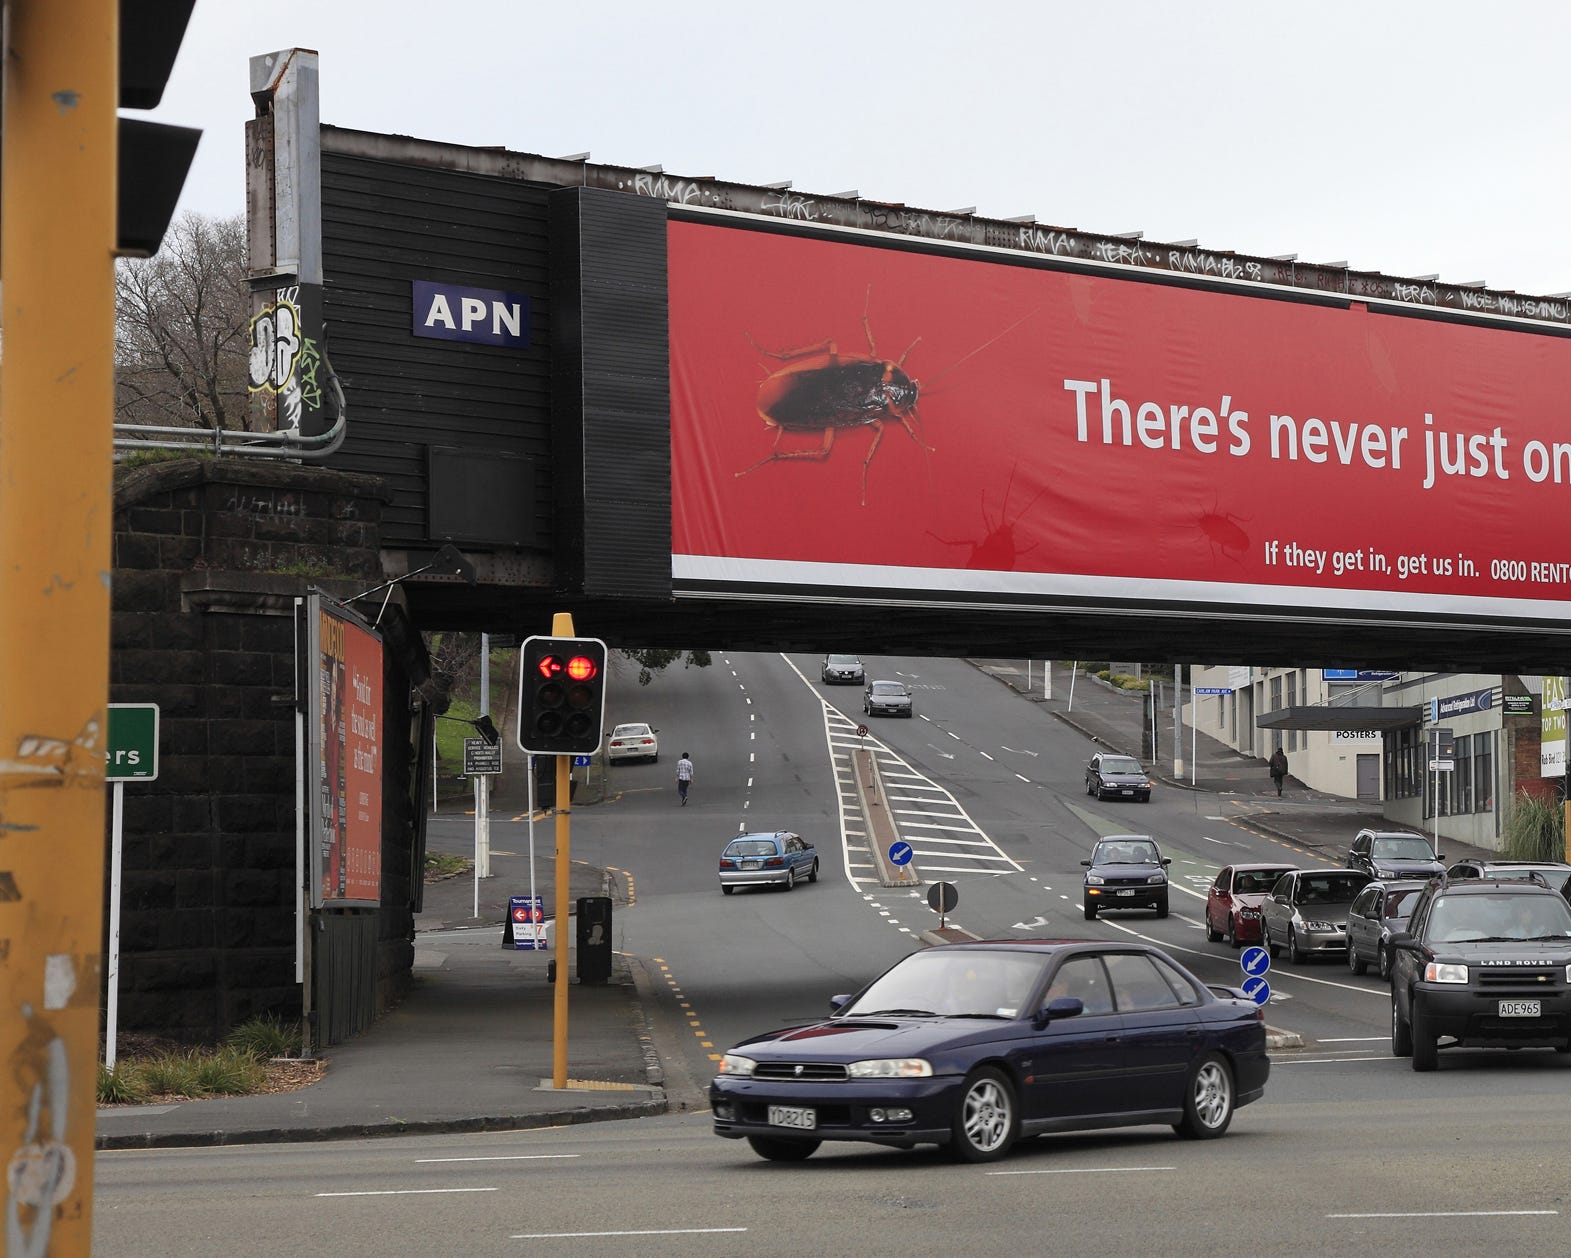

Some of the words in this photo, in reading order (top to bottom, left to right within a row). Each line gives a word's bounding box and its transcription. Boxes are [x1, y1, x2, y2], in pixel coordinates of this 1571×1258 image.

[424, 293, 521, 337] APN
[1063, 378, 1250, 456] There's
[1270, 409, 1408, 470] never
[1423, 413, 1509, 489] just
[1264, 540, 1279, 565] If
[1284, 541, 1326, 574] they
[1332, 549, 1364, 575] get
[1369, 547, 1392, 575] in,
[1397, 553, 1428, 579] get
[1432, 558, 1453, 576] us
[1458, 553, 1480, 577] in.
[1491, 559, 1527, 582] 0800
[1336, 730, 1377, 739] POSTERS
[1542, 717, 1552, 732] TOP
[1554, 715, 1565, 731] TWO
[1500, 1003, 1540, 1016] ADE965
